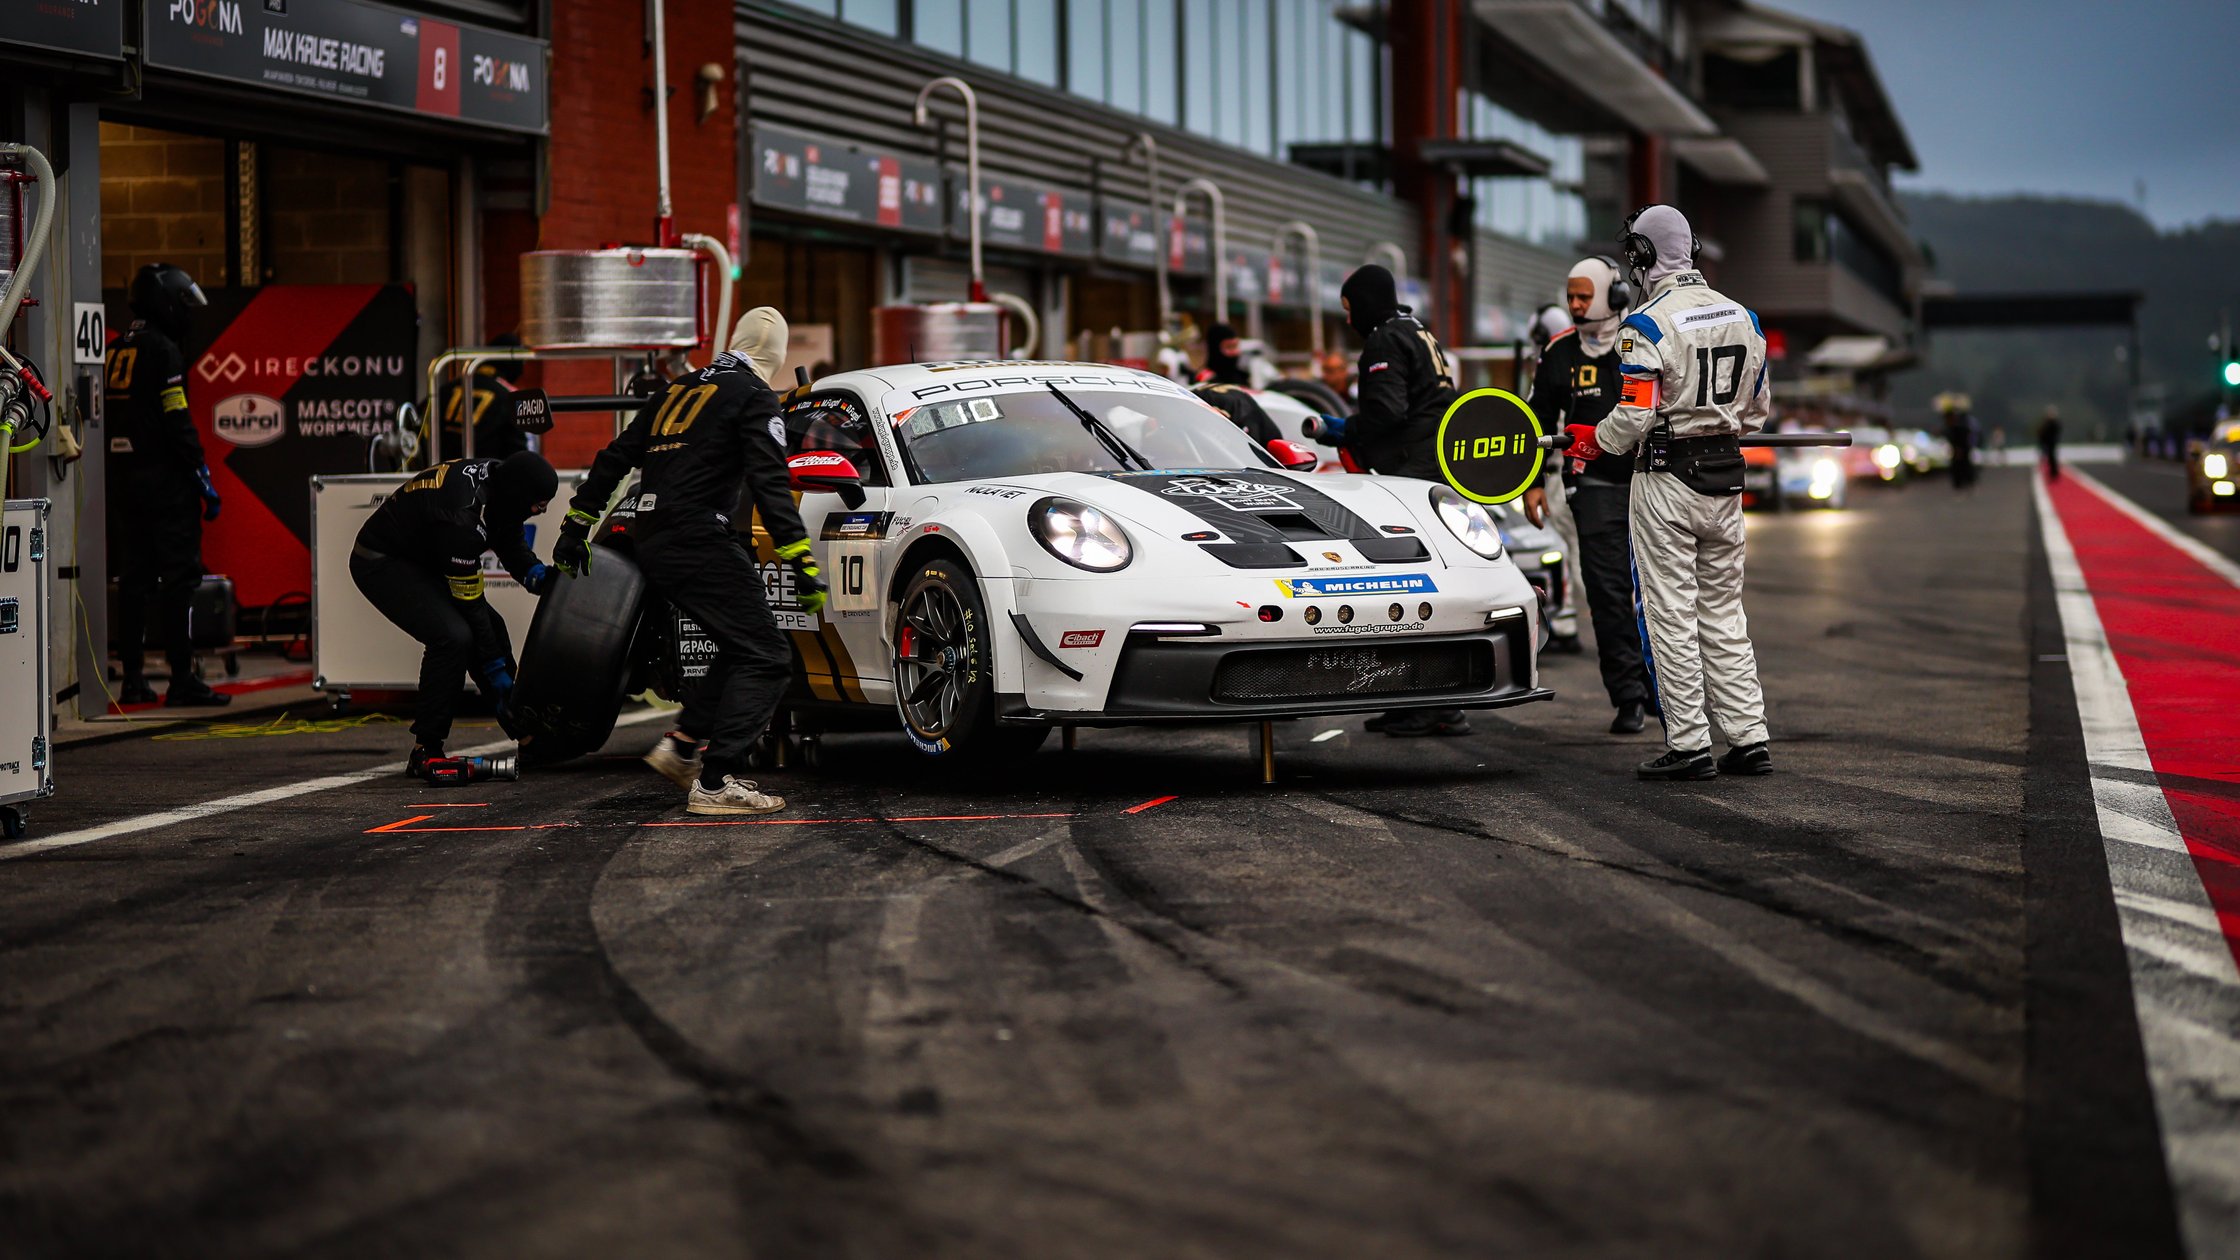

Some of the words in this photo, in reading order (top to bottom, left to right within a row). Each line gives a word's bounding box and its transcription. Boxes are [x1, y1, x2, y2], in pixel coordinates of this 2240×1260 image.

[263, 27, 294, 62] MAX
[295, 33, 339, 71] KRUSE
[340, 41, 385, 79] RACING
[433, 47, 447, 91] 8
[77, 311, 102, 357] 40
[254, 355, 404, 377] IRECKONU
[1696, 344, 1748, 407] 10
[911, 375, 1176, 400] PORSCHE
[522, 399, 545, 416] PAGID
[650, 383, 719, 437] 10
[218, 411, 278, 431] eurol
[298, 420, 395, 436] WORKWEAR
[516, 417, 545, 425] RACING
[840, 555, 863, 596] 10
[1325, 579, 1424, 591] MICHELIN
[775, 613, 807, 628] PPE
[1314, 621, 1425, 635] www.fugel-gruppe.de
[1063, 632, 1100, 646] Eibach
